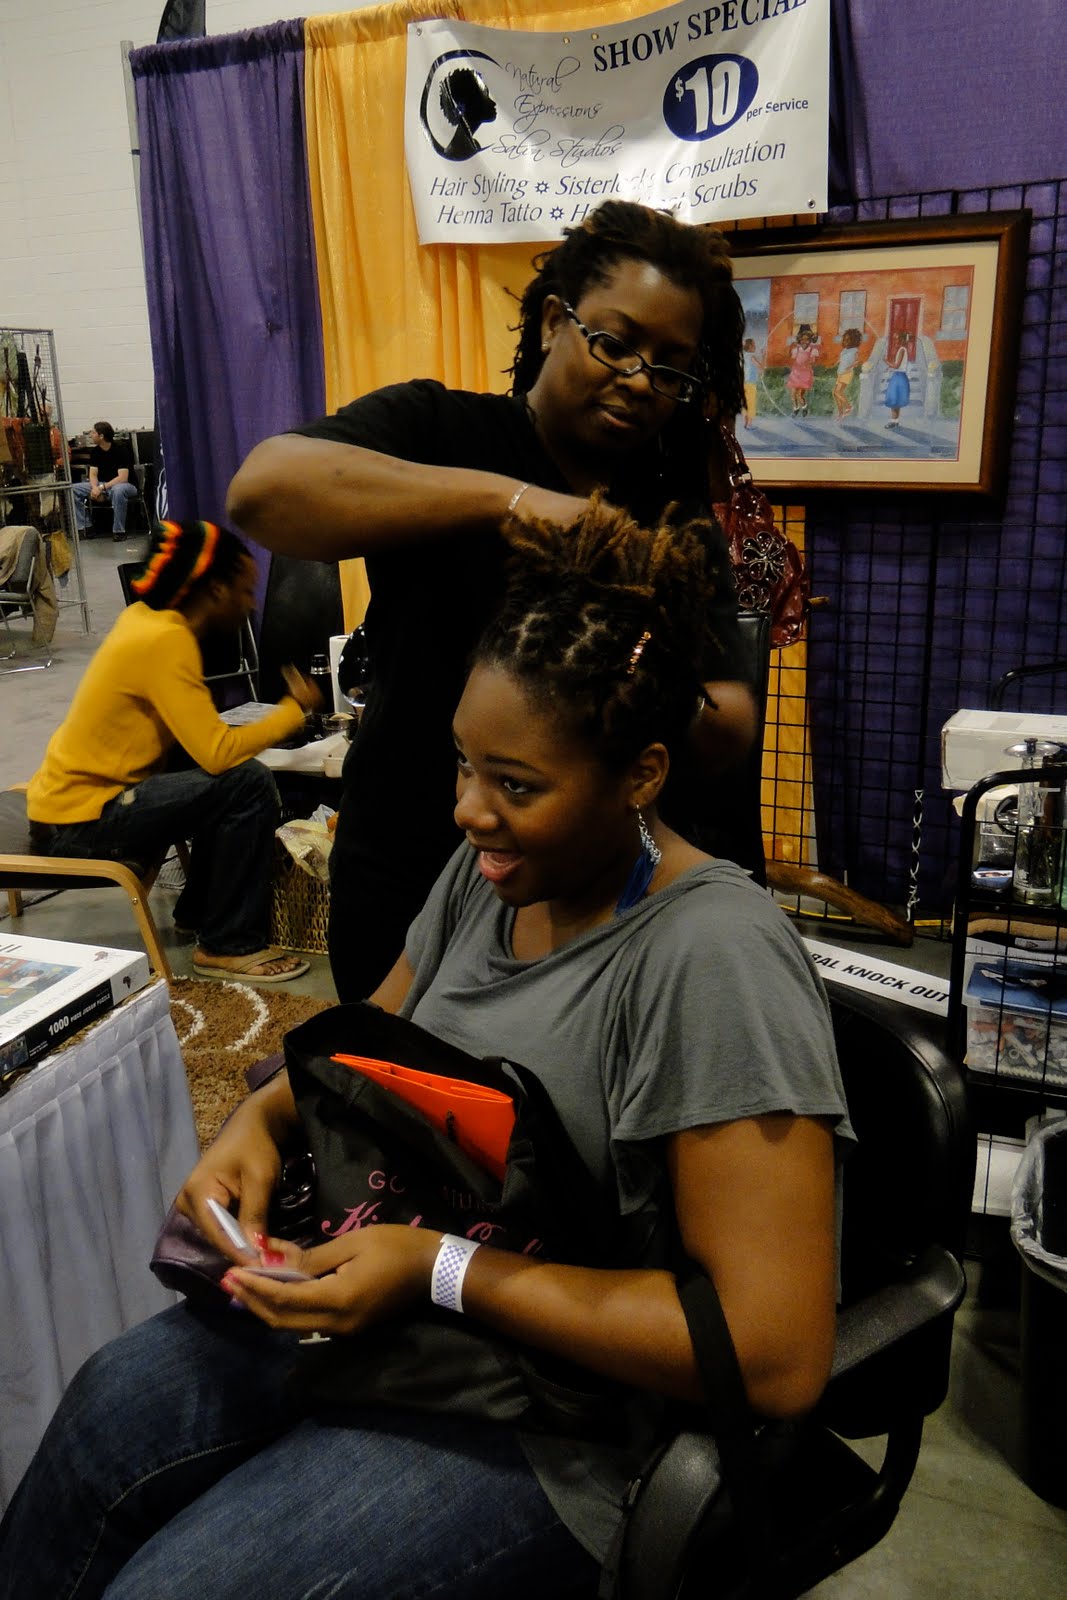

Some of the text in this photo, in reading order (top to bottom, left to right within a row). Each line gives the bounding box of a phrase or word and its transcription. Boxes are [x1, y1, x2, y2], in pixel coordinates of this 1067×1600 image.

[593, 21, 680, 72] SHOW
[505, 56, 580, 94] Natural
[674, 60, 741, 134] $10
[746, 98, 809, 121] per Service
[550, 125, 625, 168] Studios
[430, 176, 468, 196] Hair
[472, 171, 529, 203] Styling
[665, 140, 786, 184] Consultation
[437, 205, 494, 224] Henna
[500, 202, 543, 223] Tatto
[690, 173, 758, 207] Scrubs
[841, 965, 910, 990] KNOCK
[909, 985, 950, 1002] OUT
[48, 1015, 70, 1036] 1000
